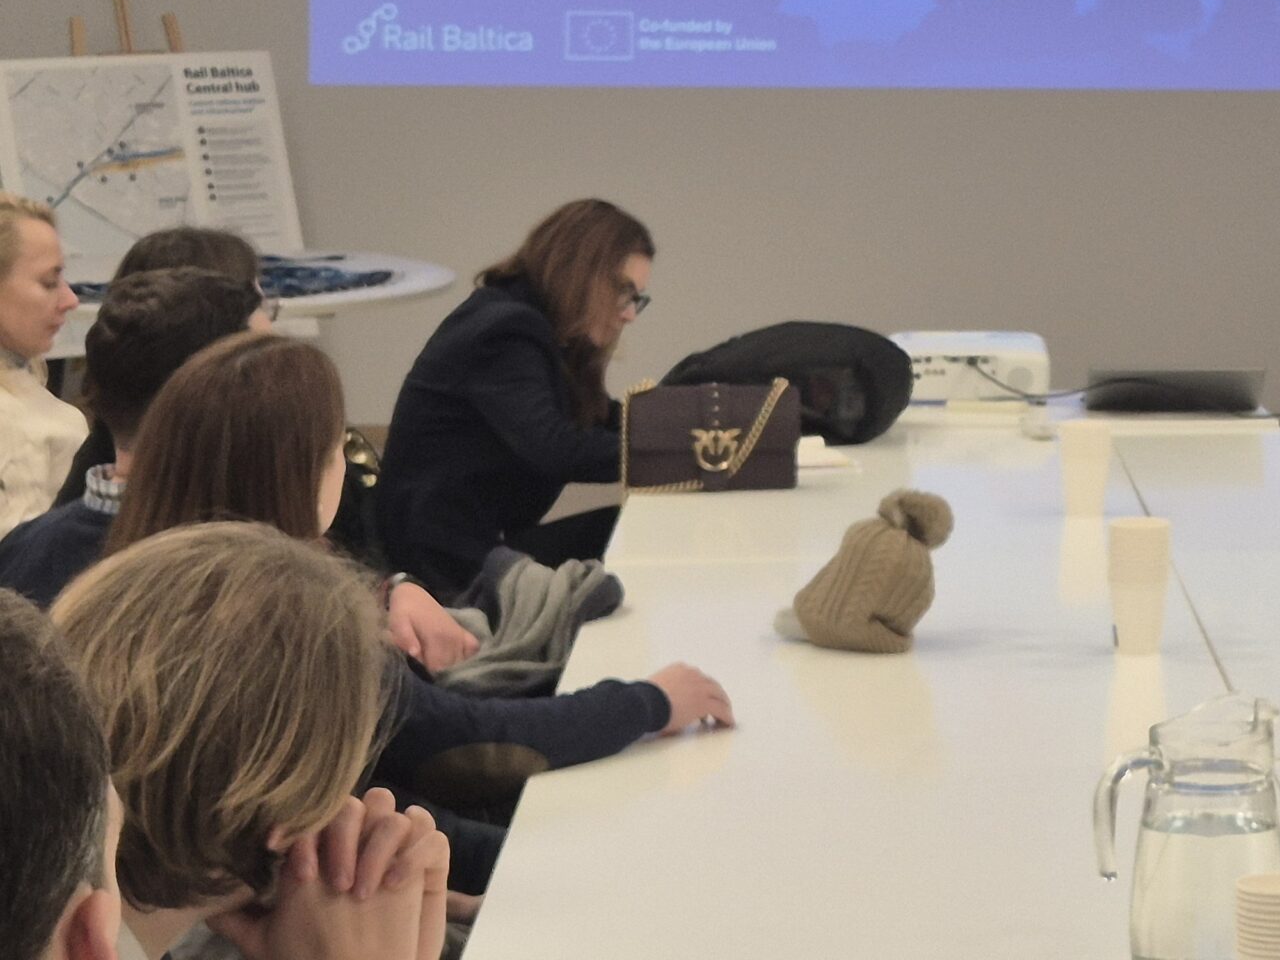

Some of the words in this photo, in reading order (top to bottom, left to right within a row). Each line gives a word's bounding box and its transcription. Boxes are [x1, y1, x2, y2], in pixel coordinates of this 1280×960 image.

[715, 20, 732, 35] by
[383, 24, 433, 52] Rail
[443, 24, 533, 52] Baltica
[184, 67, 208, 78] Rail
[210, 67, 253, 78] Baltica
[187, 81, 232, 94] Central
[235, 81, 260, 93] hub
